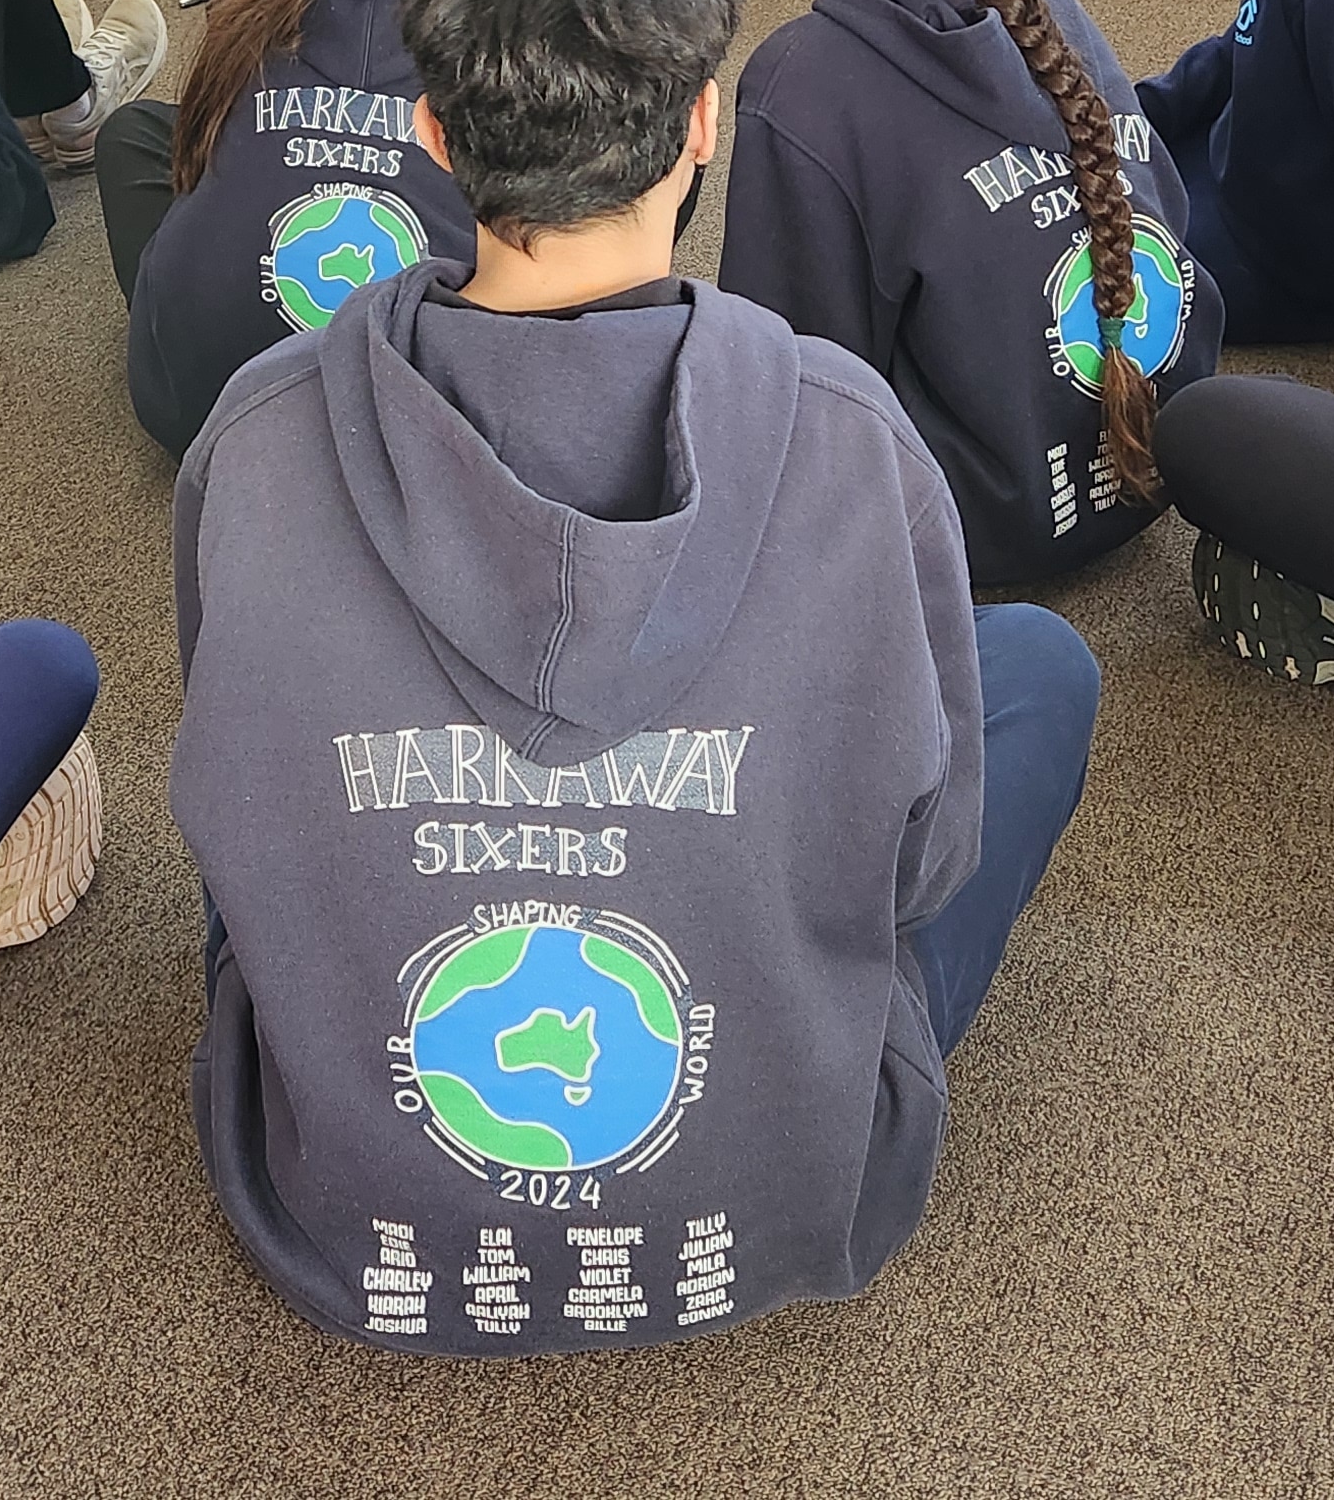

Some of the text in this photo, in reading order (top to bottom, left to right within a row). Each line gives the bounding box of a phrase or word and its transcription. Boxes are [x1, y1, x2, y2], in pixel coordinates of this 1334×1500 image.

[254, 86, 427, 148] HARKAW
[283, 136, 404, 178] SIXERS
[1031, 169, 1133, 229] SIXS
[259, 181, 374, 303] OUR SHAPING
[1181, 259, 1195, 321] WORLD
[1044, 326, 1070, 377] OUR
[1094, 493, 1117, 513] TULLY
[333, 724, 756, 815] HARKAWAY
[412, 821, 628, 877] SIXERS
[387, 900, 716, 1113] OUR SHAPING WORLD
[499, 1169, 602, 1210] 2024
[479, 1227, 513, 1247] ELAI
[566, 1226, 645, 1247] PENELOPE
[685, 1211, 727, 1239] TILLY
[477, 1247, 515, 1264] TOM
[580, 1247, 631, 1266] CHRIS
[677, 1229, 734, 1261] JULIAN
[462, 1265, 532, 1285] WILLIAM
[579, 1267, 633, 1286] VIOLET
[686, 1252, 727, 1277] MILA
[363, 1266, 434, 1293] CHARLEY
[676, 1266, 736, 1297] ADRIAN
[474, 1284, 521, 1304] APRIL
[568, 1285, 644, 1304] CARMELA
[685, 1287, 727, 1311] ZARA
[464, 1302, 531, 1320] AALIYAH
[563, 1302, 649, 1319] BROOKLYN
[677, 1299, 735, 1326] SONNY
[364, 1316, 428, 1335] JOSHUA
[474, 1319, 522, 1335] TULLY
[584, 1319, 629, 1332] BILLIE
